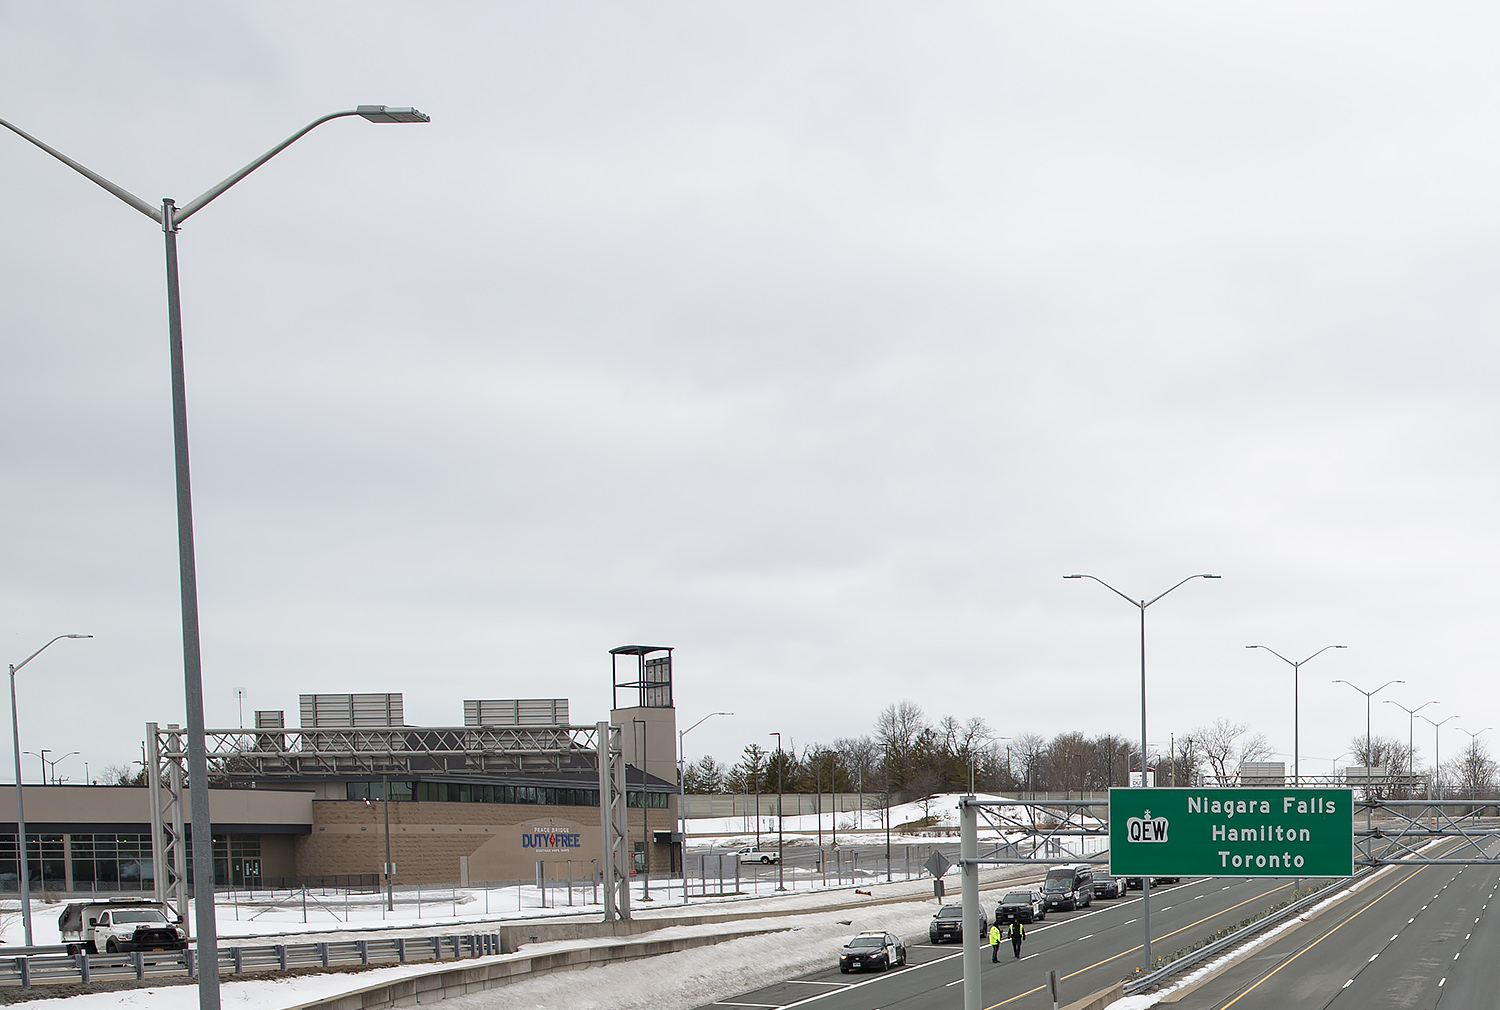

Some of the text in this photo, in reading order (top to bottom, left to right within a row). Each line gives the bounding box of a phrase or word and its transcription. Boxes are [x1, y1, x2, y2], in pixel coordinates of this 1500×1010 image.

[1187, 796, 1336, 818] Niagara Falls
[1130, 820, 1166, 841] QEW
[1212, 824, 1311, 842] Hamilton
[522, 833, 581, 848] DUTY FREE
[1217, 851, 1305, 868] Toronto
